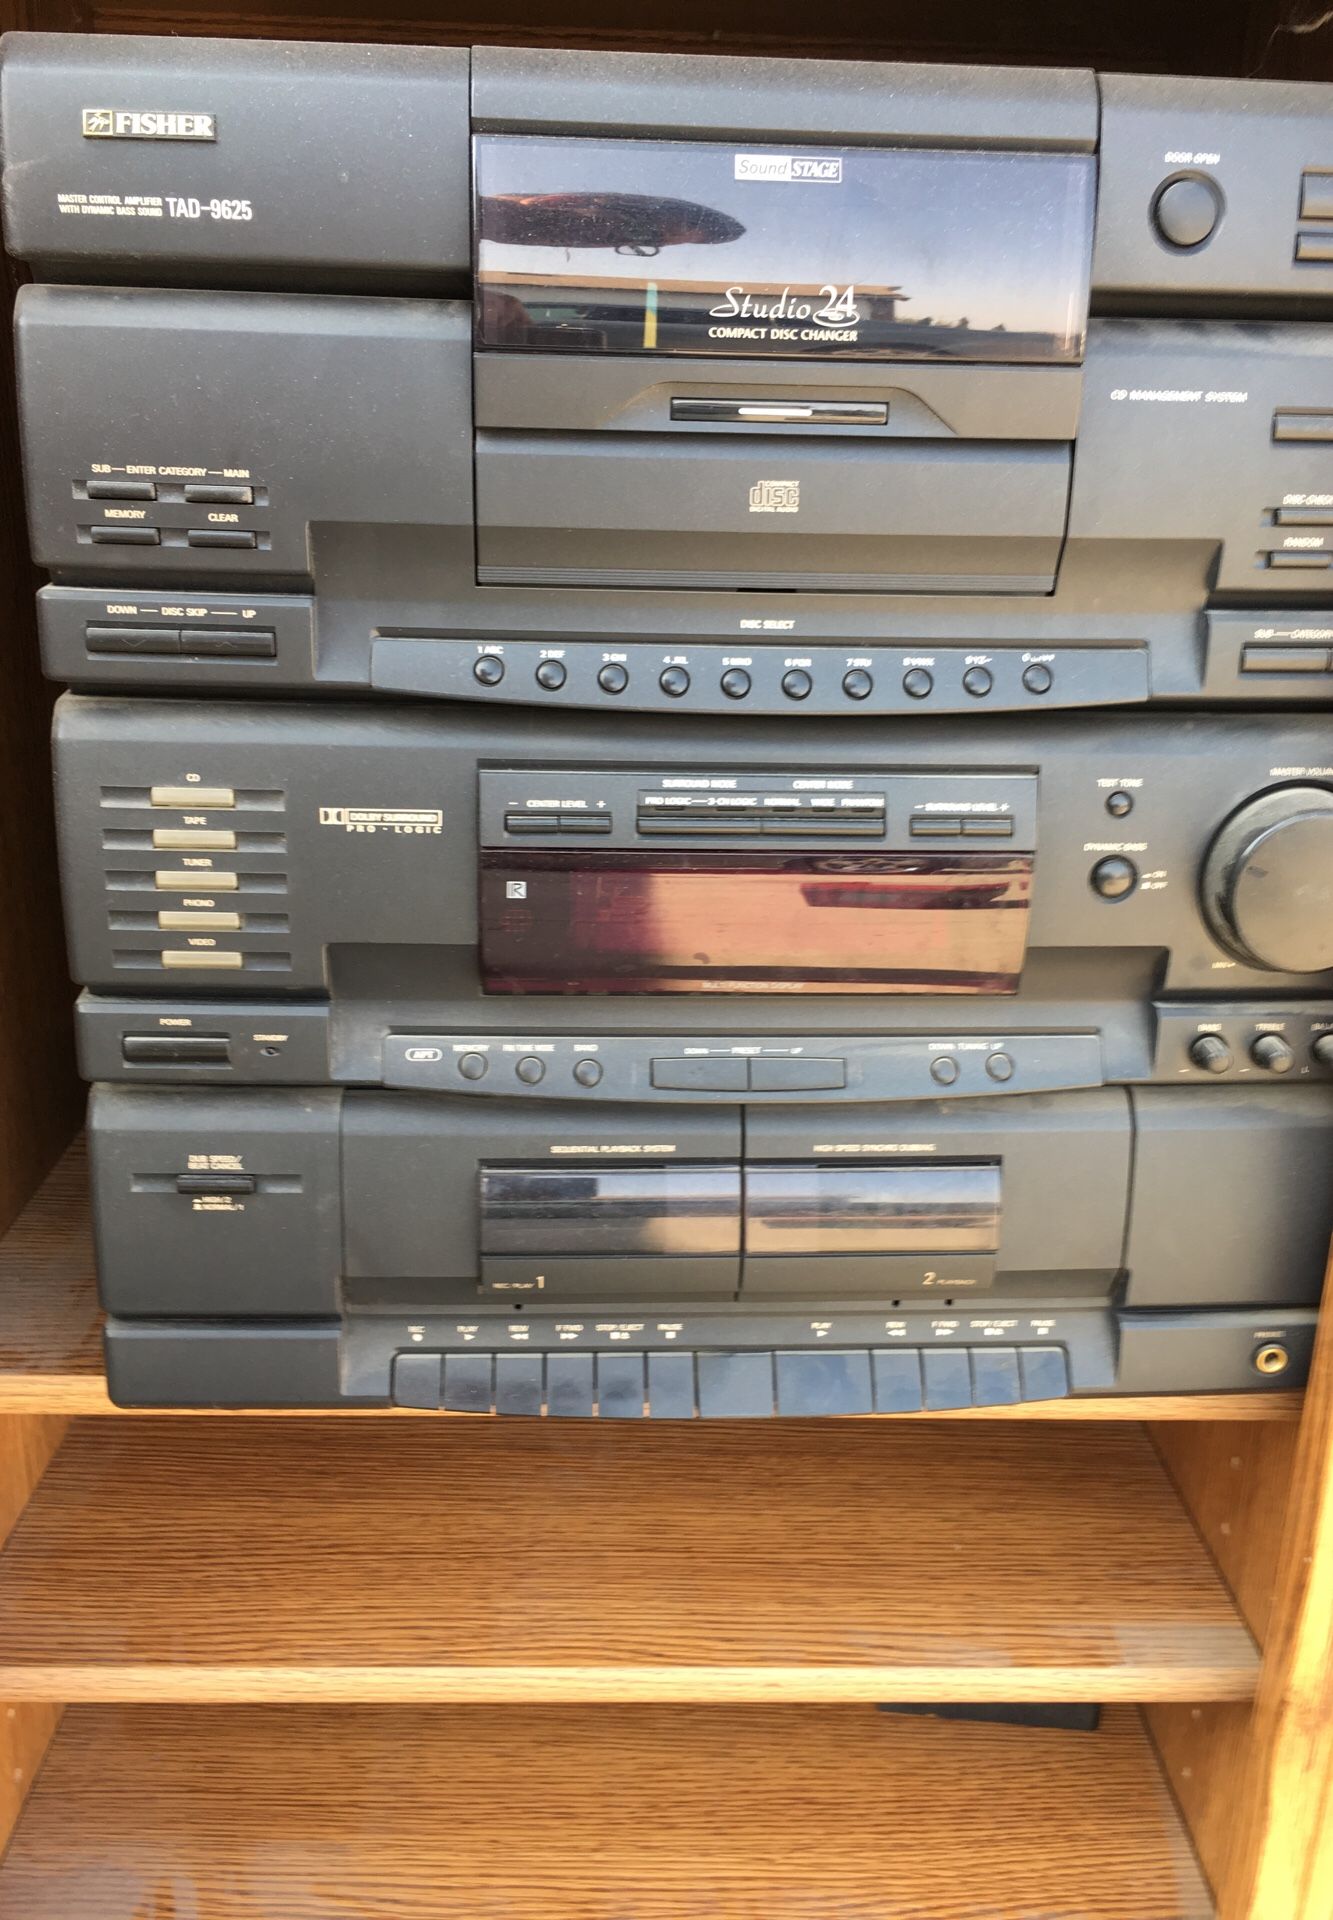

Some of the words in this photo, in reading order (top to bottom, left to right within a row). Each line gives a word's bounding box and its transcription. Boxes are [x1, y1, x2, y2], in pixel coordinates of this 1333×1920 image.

[115, 112, 215, 138] FISHER
[738, 158, 789, 176] Sound
[791, 161, 840, 179] STAGE
[57, 193, 87, 204] MASTER
[88, 194, 122, 205] CONTROL
[124, 195, 163, 207] AMPLIFIER
[59, 204, 80, 214] WITH
[81, 205, 115, 215] DYNAMIC
[116, 206, 136, 216] BASS
[137, 207, 163, 218] SOUND
[165, 197, 253, 221] TAD-9625
[708, 286, 812, 320] Studio
[815, 284, 859, 320] 24
[708, 326, 768, 340] COMPACT
[770, 327, 799, 341] DISC
[800, 328, 859, 342] CHANGER
[91, 464, 112, 473] SUB
[126, 465, 156, 475] ENTER
[158, 466, 207, 477] CATEGORY
[223, 468, 250, 478] MAIN
[104, 509, 146, 519] MEMORY
[207, 512, 239, 523] CLEAR
[106, 604, 138, 615] DOWN
[161, 606, 184, 616] DISC
[186, 607, 208, 617] SKIP
[241, 609, 257, 619] UP
[185, 773, 201, 782] CD
[182, 816, 208, 825] TAPE
[182, 858, 213, 867] TUNER
[182, 899, 216, 908] PHONO
[187, 938, 217, 946] VIDEO
[536, 1276, 545, 1289] 1
[922, 1271, 937, 1285] 2
